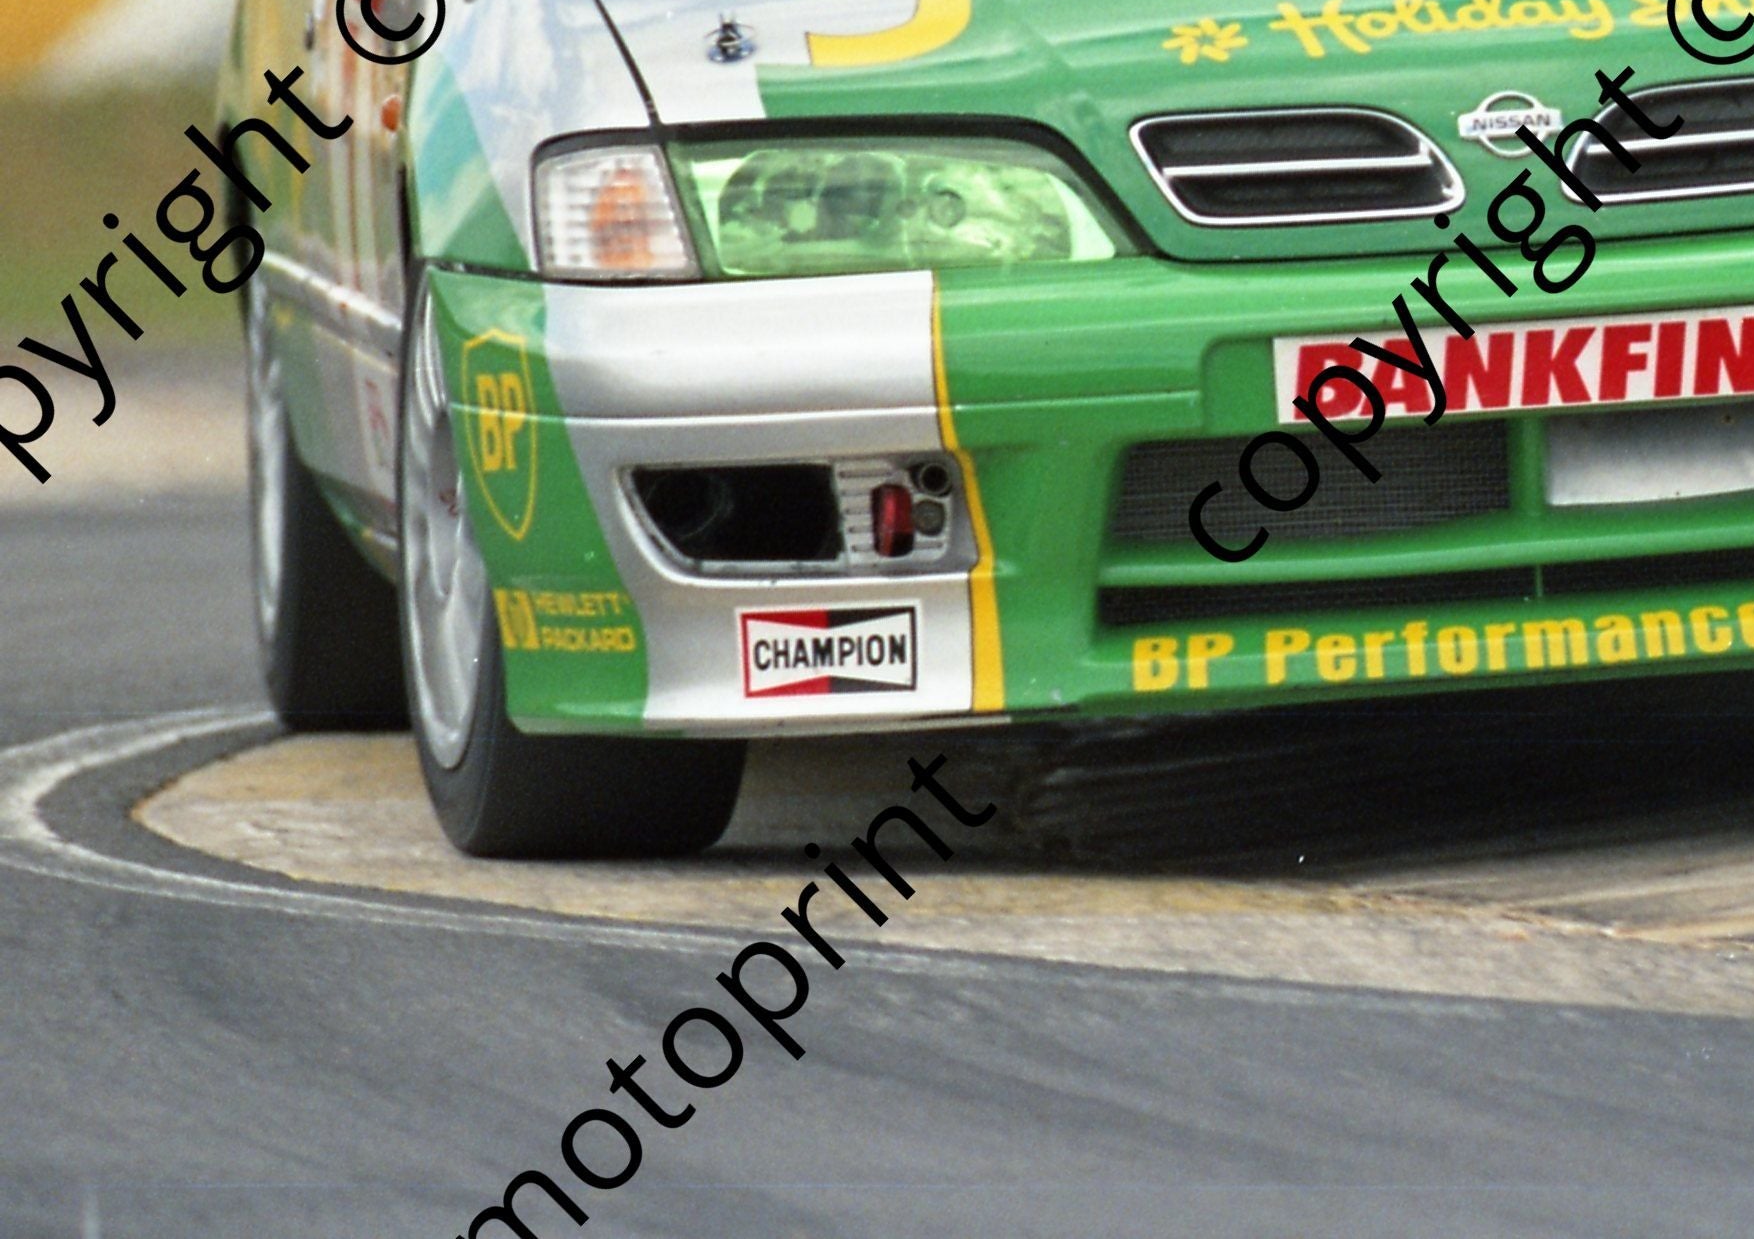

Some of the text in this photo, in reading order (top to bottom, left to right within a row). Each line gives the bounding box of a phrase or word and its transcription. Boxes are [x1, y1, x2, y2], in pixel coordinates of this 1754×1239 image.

[1472, 113, 1551, 132] NISSAN
[475, 372, 527, 472] BP
[753, 633, 907, 671] CHAMPION
[1131, 633, 1235, 693] BP
